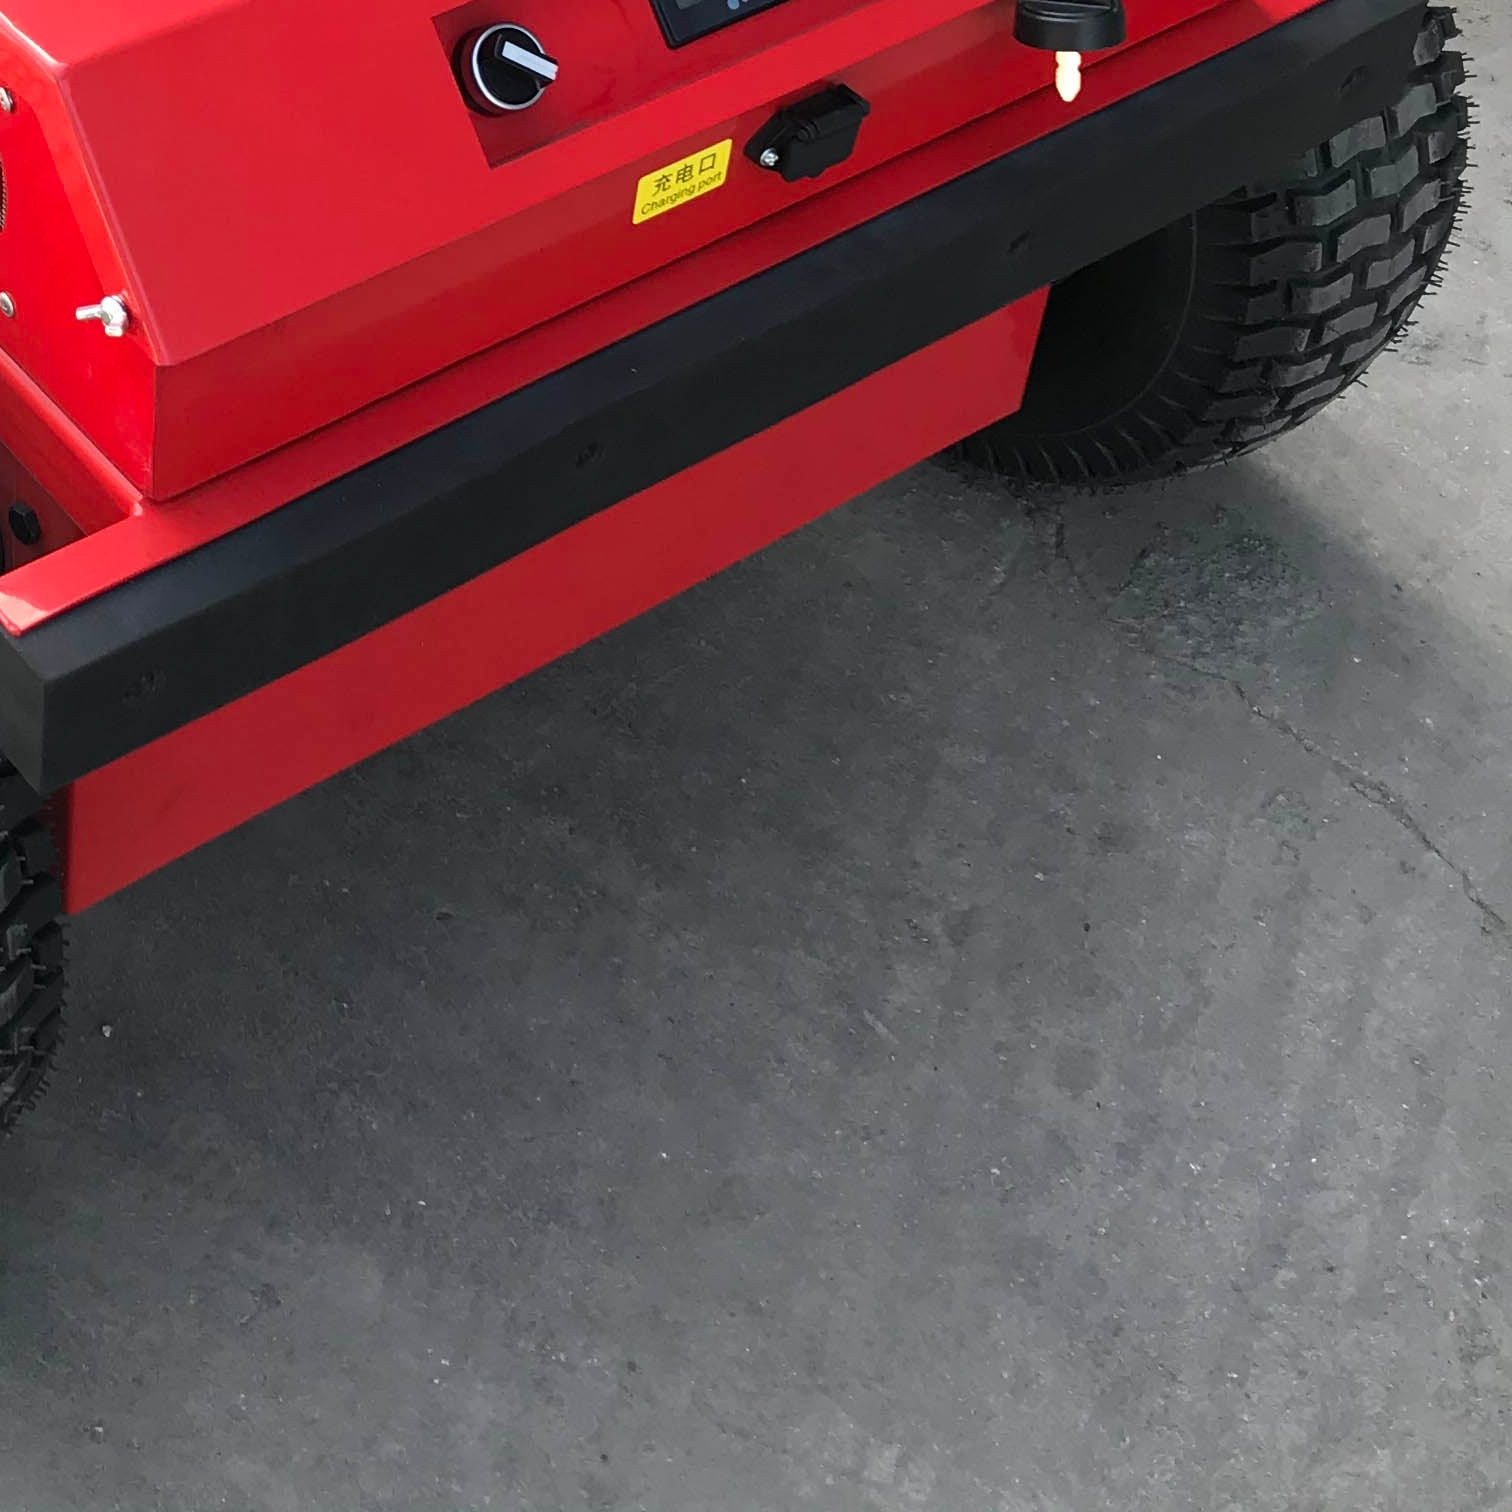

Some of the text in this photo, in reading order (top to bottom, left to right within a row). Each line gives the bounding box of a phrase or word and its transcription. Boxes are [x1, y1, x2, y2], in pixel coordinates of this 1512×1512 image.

[640, 171, 722, 215] Charging port
[652, 152, 716, 197] 充电口
